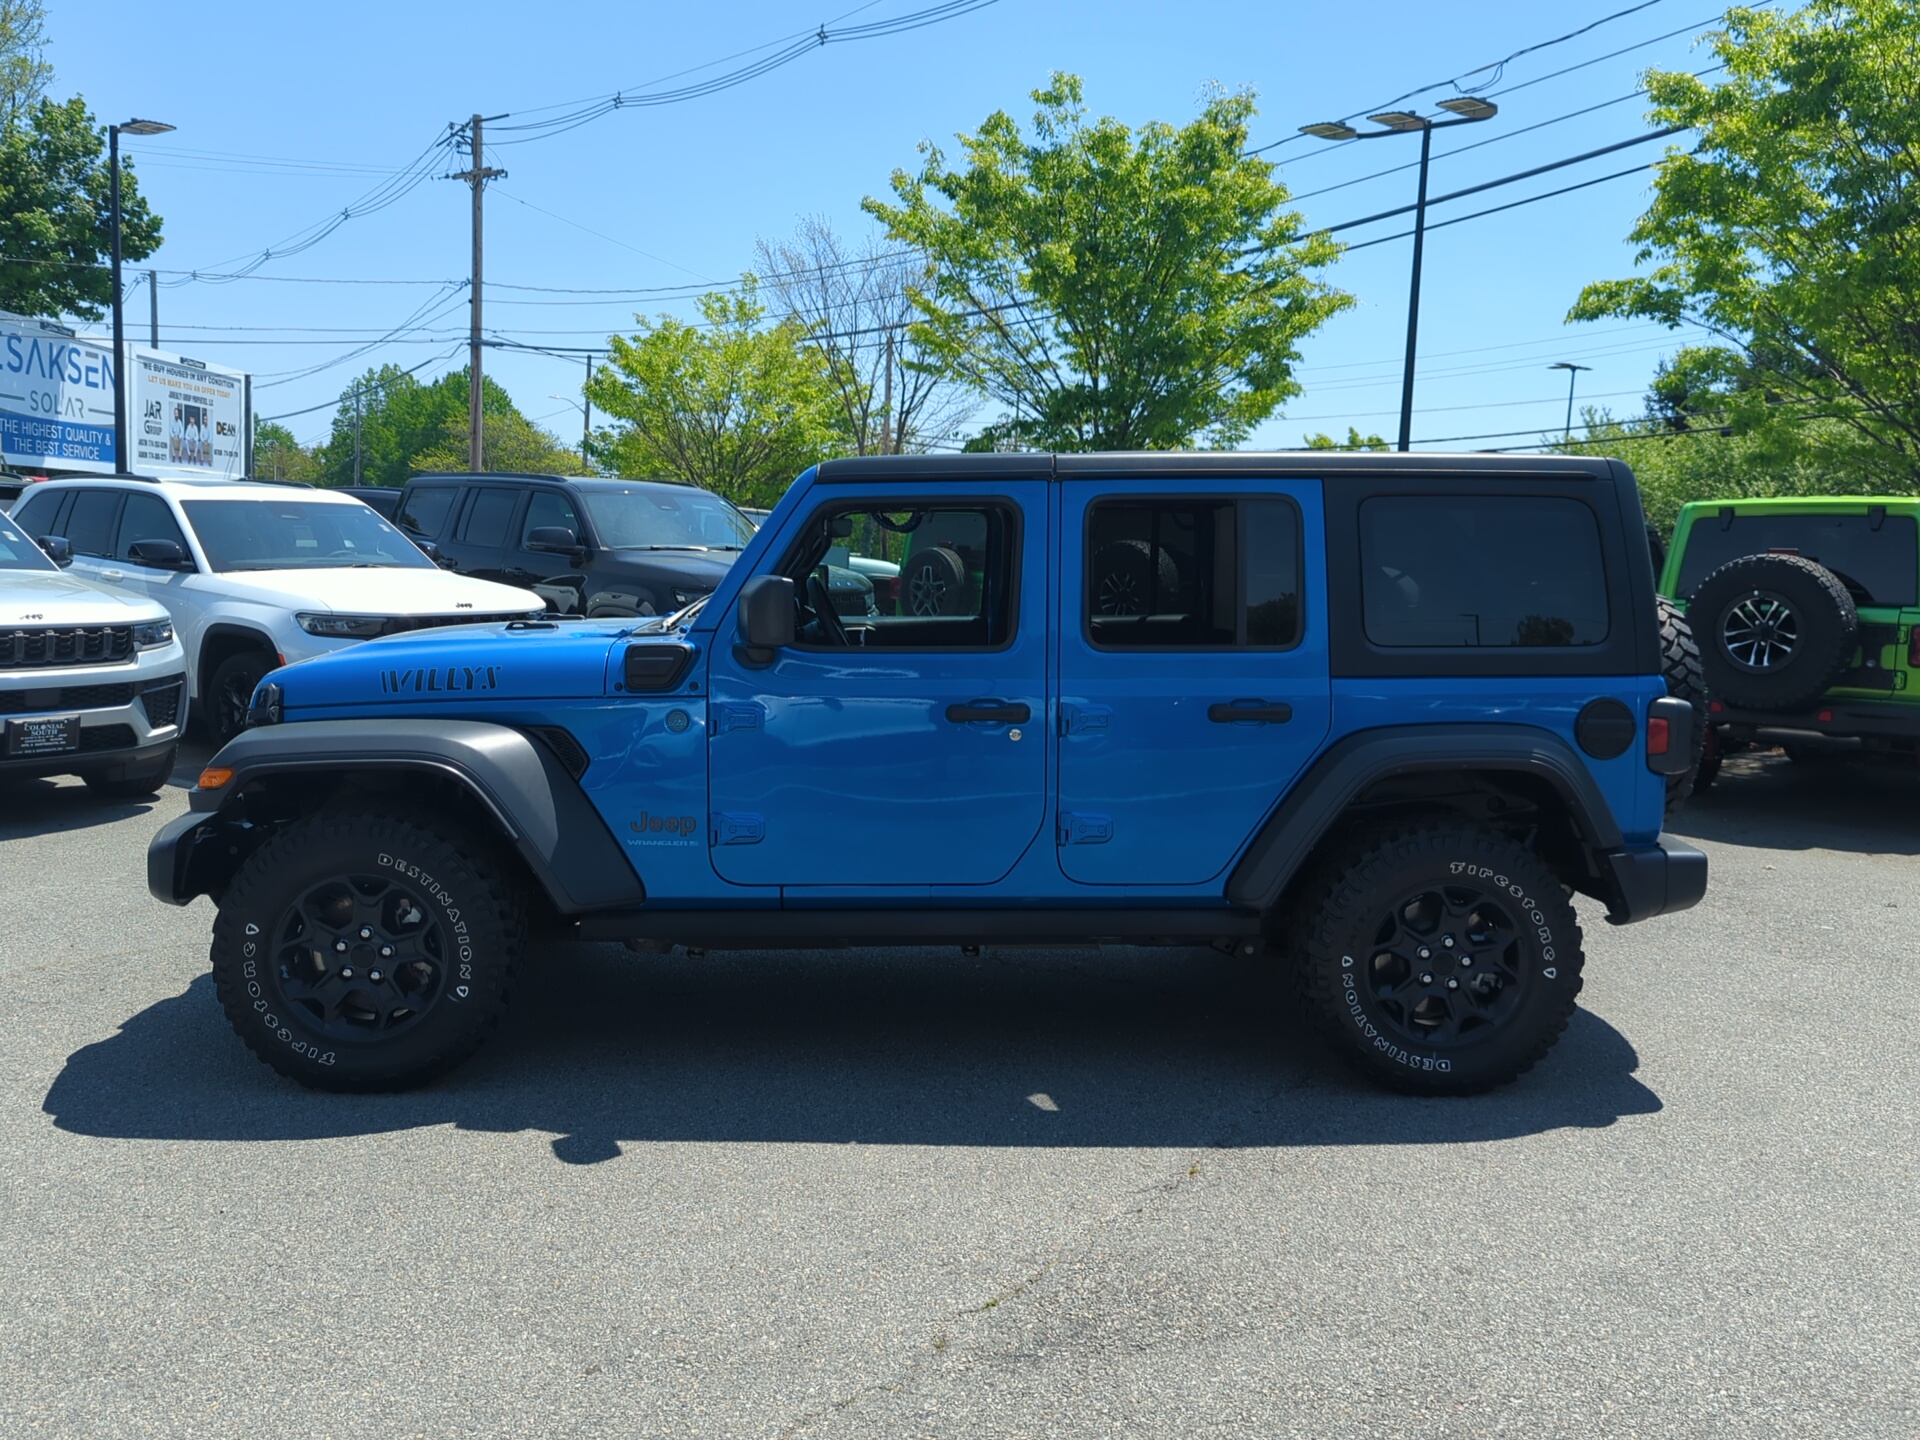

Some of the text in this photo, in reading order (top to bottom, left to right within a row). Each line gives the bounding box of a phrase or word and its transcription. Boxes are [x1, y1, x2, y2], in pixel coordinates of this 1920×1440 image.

[143, 362, 234, 389] WE BUY HOUSES IN ANY CONDITION
[148, 375, 158, 384] LET
[159, 377, 166, 385] US
[167, 379, 181, 388] MAKE
[183, 382, 192, 391] YOU
[201, 387, 216, 396] OFFER
[29, 390, 84, 419] SOLAR
[144, 399, 162, 420] JAR
[0, 418, 111, 446] THE HIGHEST QUALITY &
[216, 421, 236, 437] DEAN
[13, 437, 100, 460] THE BEST SERVICE
[455, 601, 473, 609] Jeep
[380, 665, 503, 694] WILLYS
[24, 722, 66, 731] COLONIAL
[630, 810, 697, 838] Jeep
[627, 839, 688, 847] WRANGLER
[377, 853, 472, 980] DESTINATION
[1450, 861, 1555, 961] Firestone
[243, 942, 336, 1066] Firestone
[1342, 973, 1451, 1072] DESTINATION
